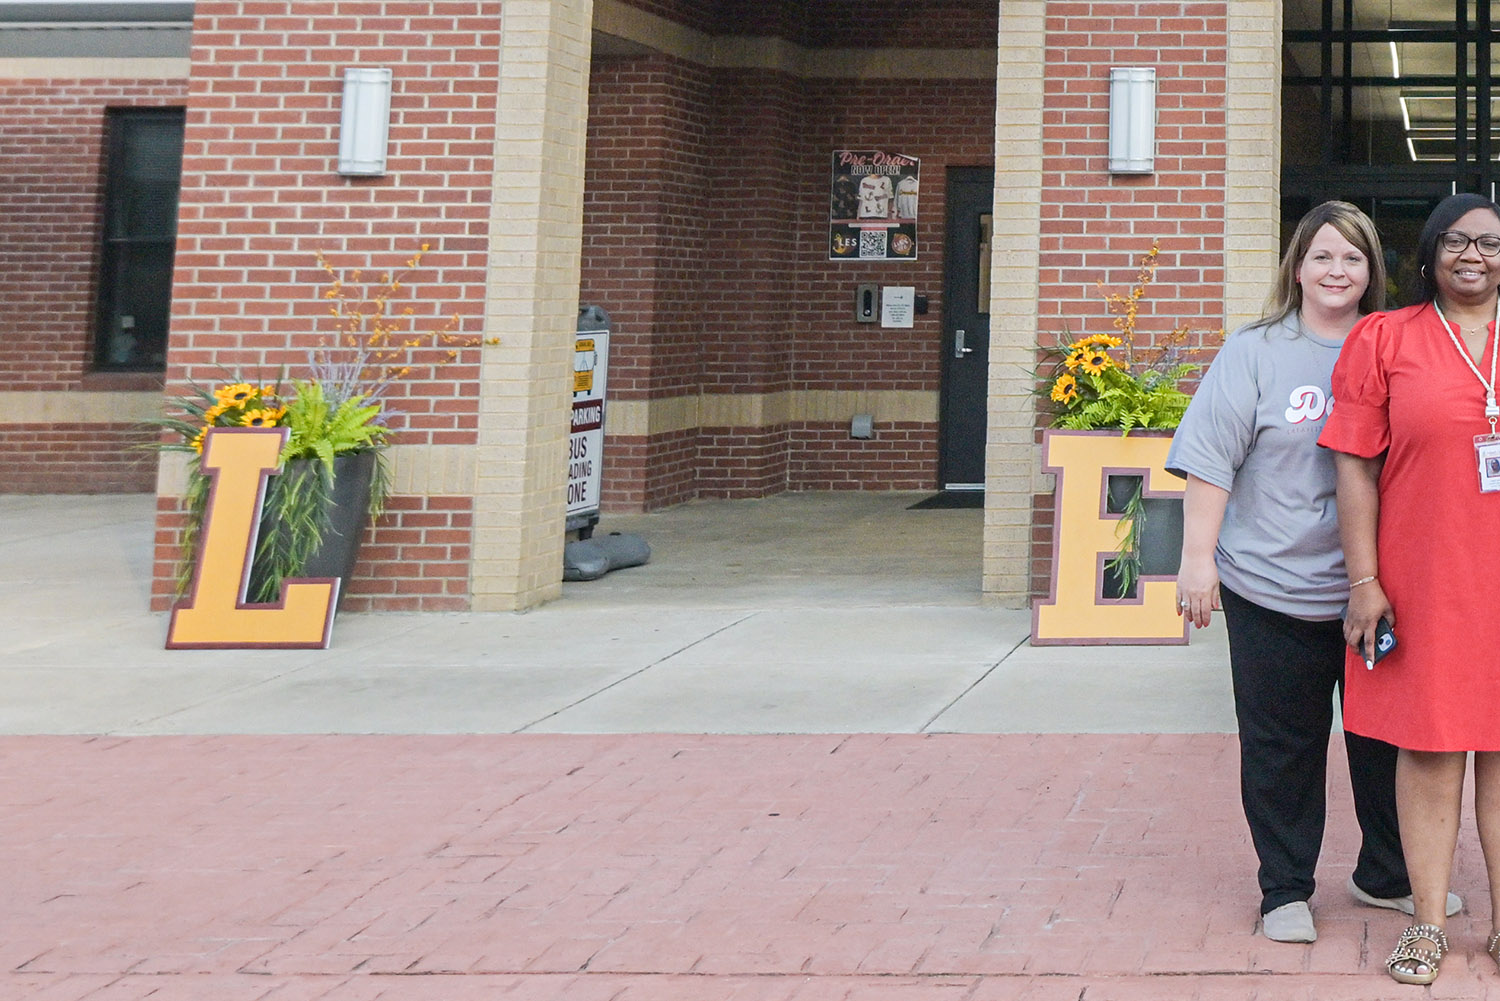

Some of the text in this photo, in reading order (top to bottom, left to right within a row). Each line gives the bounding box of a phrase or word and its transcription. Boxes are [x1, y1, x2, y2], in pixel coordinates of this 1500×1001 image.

[839, 151, 915, 167] Pre-Orde
[850, 165, 873, 176] NOW
[838, 238, 857, 247] LES
[567, 460, 592, 480] ADING
[567, 481, 587, 505] ONE
[164, 426, 342, 650] L
[1030, 428, 1191, 647] E
